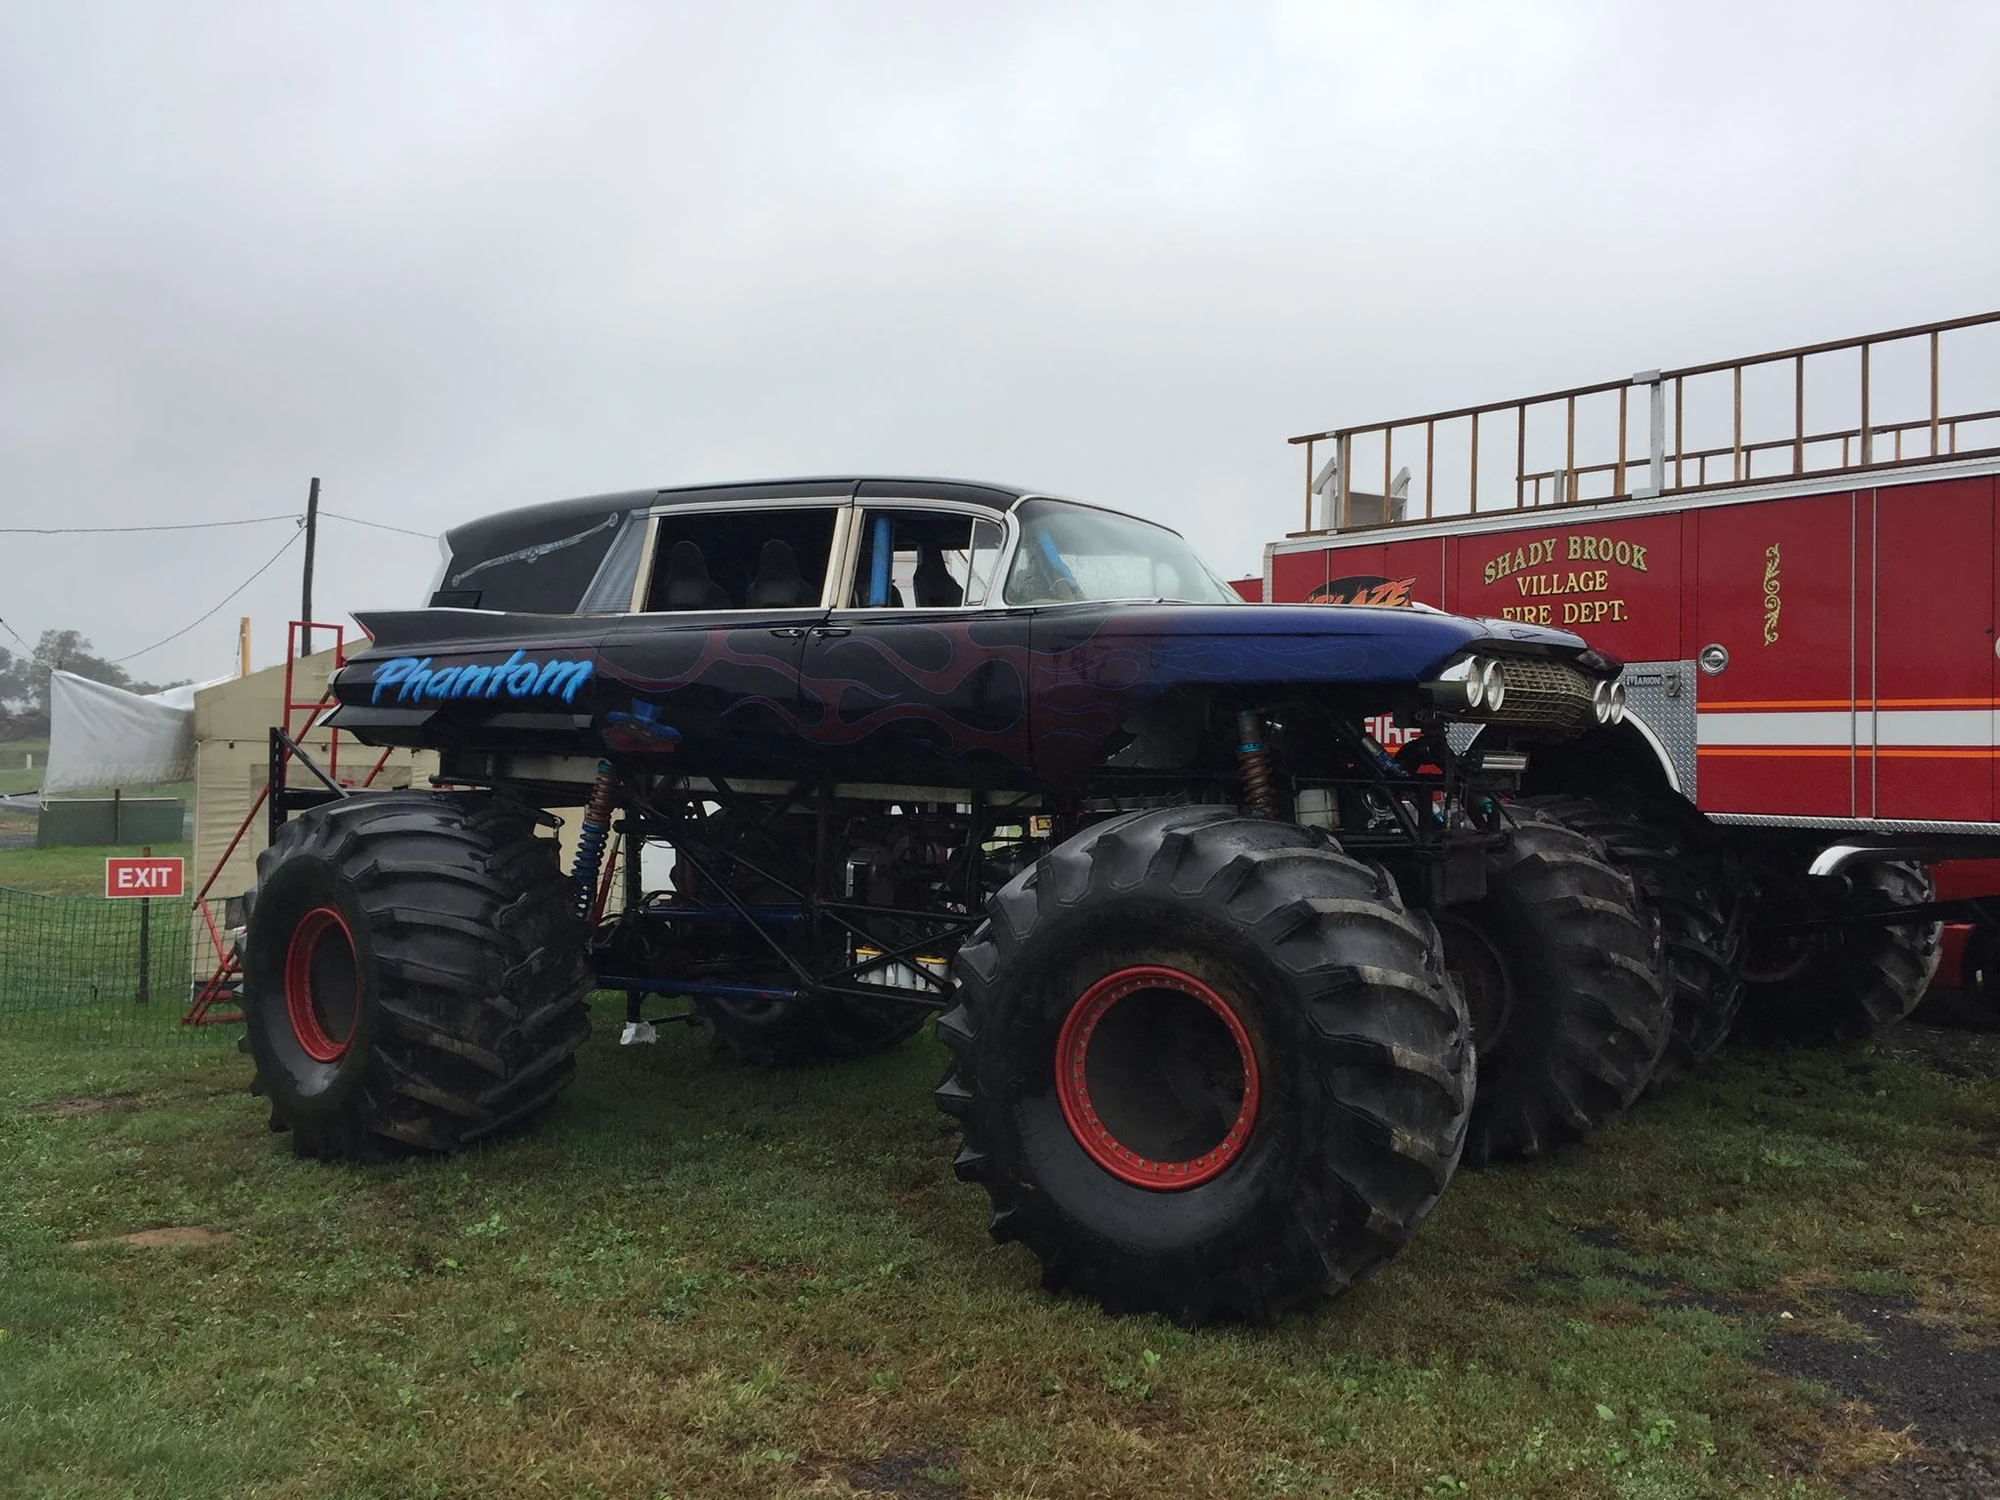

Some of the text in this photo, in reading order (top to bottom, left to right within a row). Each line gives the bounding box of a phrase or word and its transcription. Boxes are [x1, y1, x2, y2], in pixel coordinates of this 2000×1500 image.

[1484, 535, 1648, 585] SHADY BROOK
[1309, 577, 1417, 606] AZE
[1516, 569, 1609, 597] VILLAGE
[1502, 599, 1628, 625] FIRE DEPT.
[372, 647, 594, 705] Phantom
[118, 867, 173, 888] EXIT
